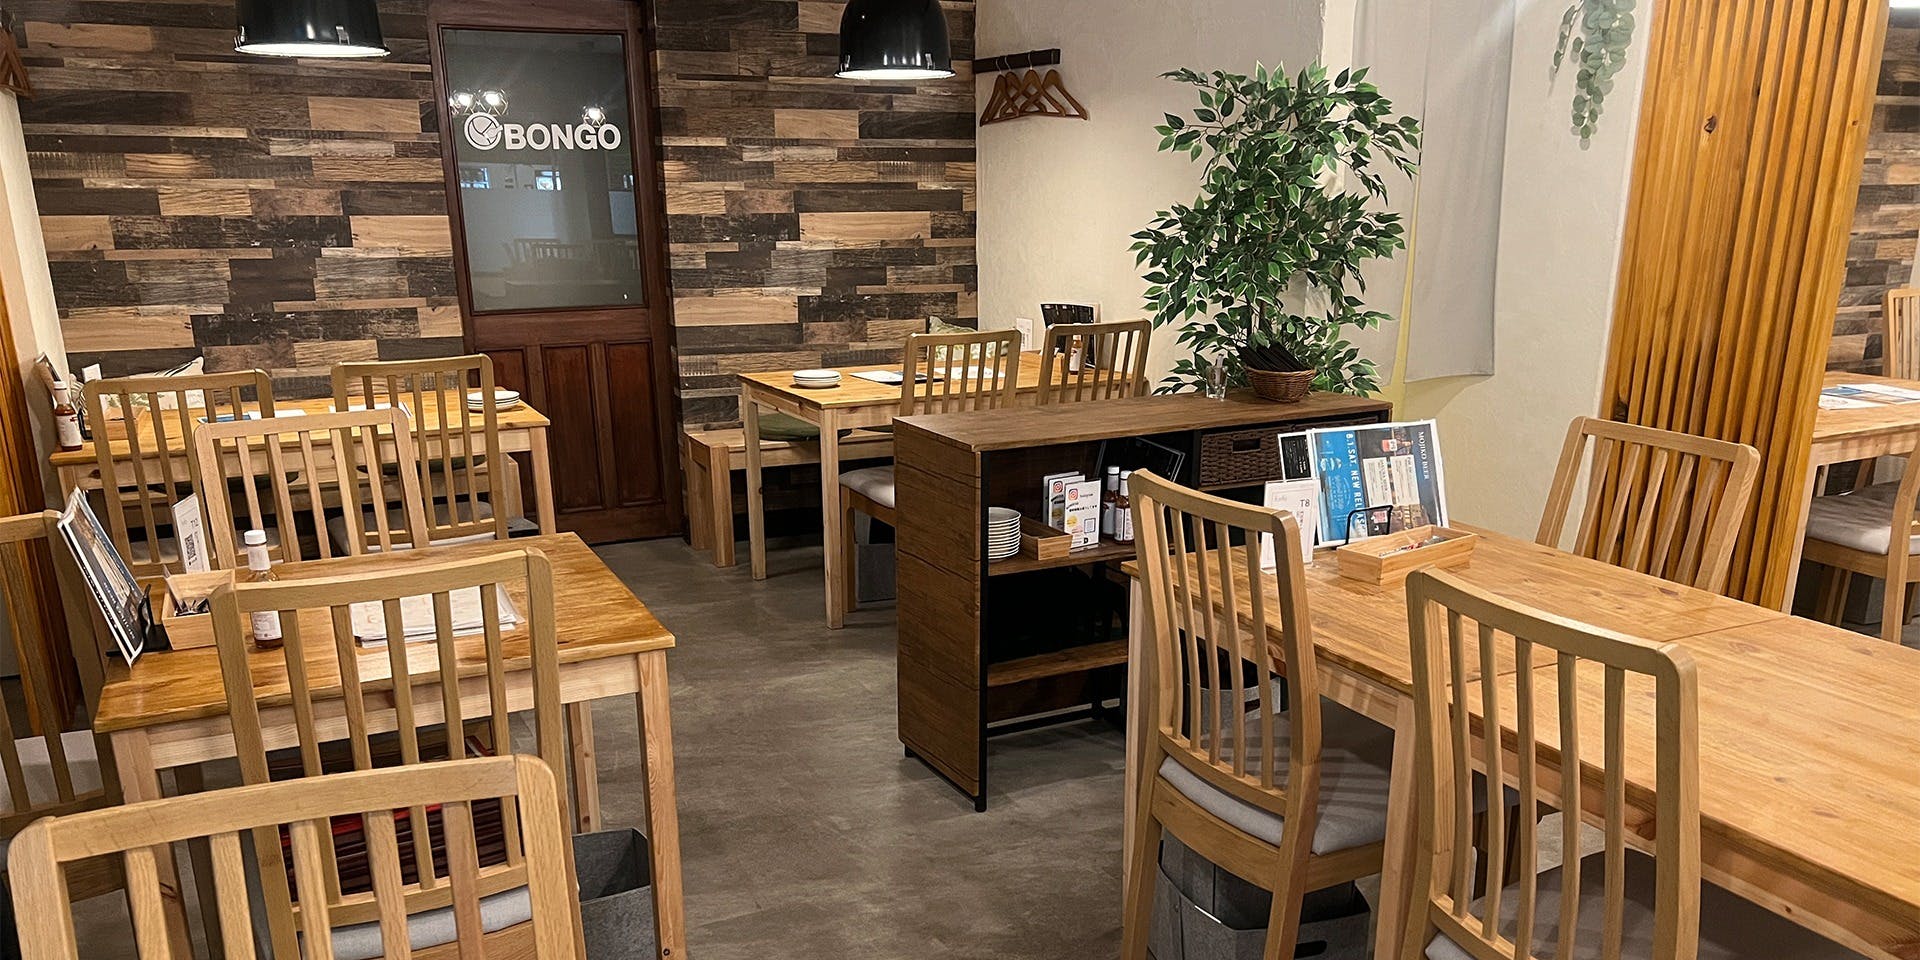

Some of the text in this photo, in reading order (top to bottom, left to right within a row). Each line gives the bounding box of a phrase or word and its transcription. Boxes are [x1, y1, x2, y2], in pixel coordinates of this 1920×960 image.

[503, 123, 622, 150] BONGO
[1418, 431, 1427, 460] MOJIKO
[1351, 470, 1361, 489] NEW
[1299, 498, 1310, 508] T8
[1354, 491, 1366, 529] RELAS
